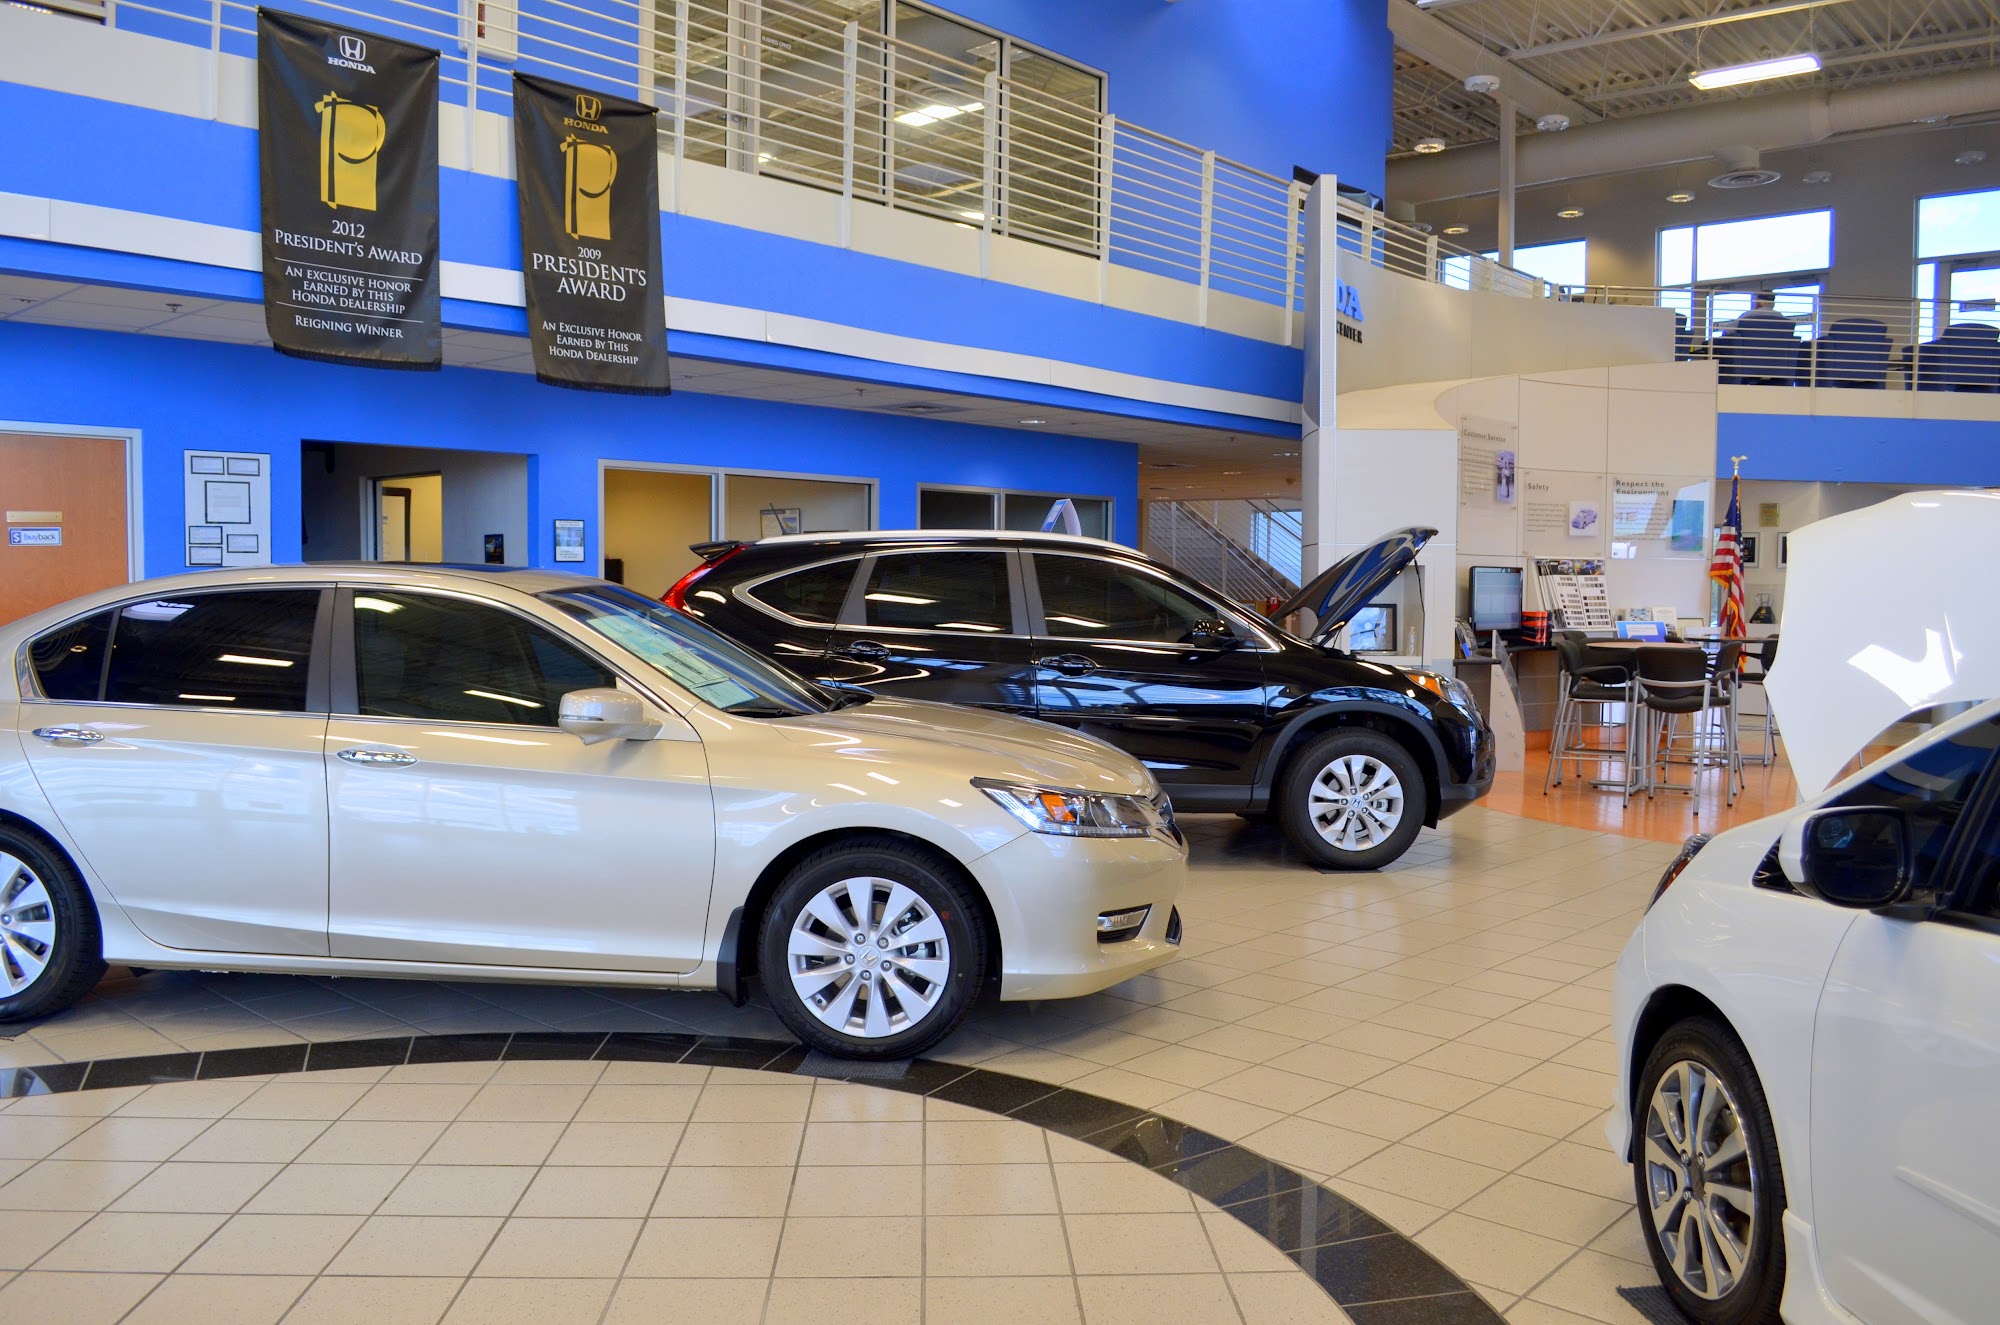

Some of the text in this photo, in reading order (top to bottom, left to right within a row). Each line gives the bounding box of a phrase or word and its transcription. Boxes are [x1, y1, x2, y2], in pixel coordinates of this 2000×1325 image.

[327, 56, 377, 75] HONDA
[563, 117, 609, 134] HONDA
[331, 219, 366, 239] 2012
[274, 228, 423, 265] PRESIDENT'S AWARD
[577, 246, 602, 260] 2009
[285, 265, 412, 293] AN EXCLUSIVE HONOR
[532, 253, 646, 286] PRESIDENT'S
[303, 280, 394, 302] EARNED BY THIS
[556, 276, 627, 302] AWARD
[292, 289, 406, 315] HONDA DEALERSHIP
[295, 314, 404, 339] REIGNING WINNER
[542, 320, 643, 342] AN EXCLUSIVE HONOR
[556, 334, 629, 353] EARNED BY THIS
[549, 346, 639, 364] HONDA DEALERSHIP
[1463, 428, 1506, 443] Customer Service
[1527, 482, 1550, 491] Safety
[1615, 479, 1665, 488] Respect the
[1616, 488, 1669, 496] Environment
